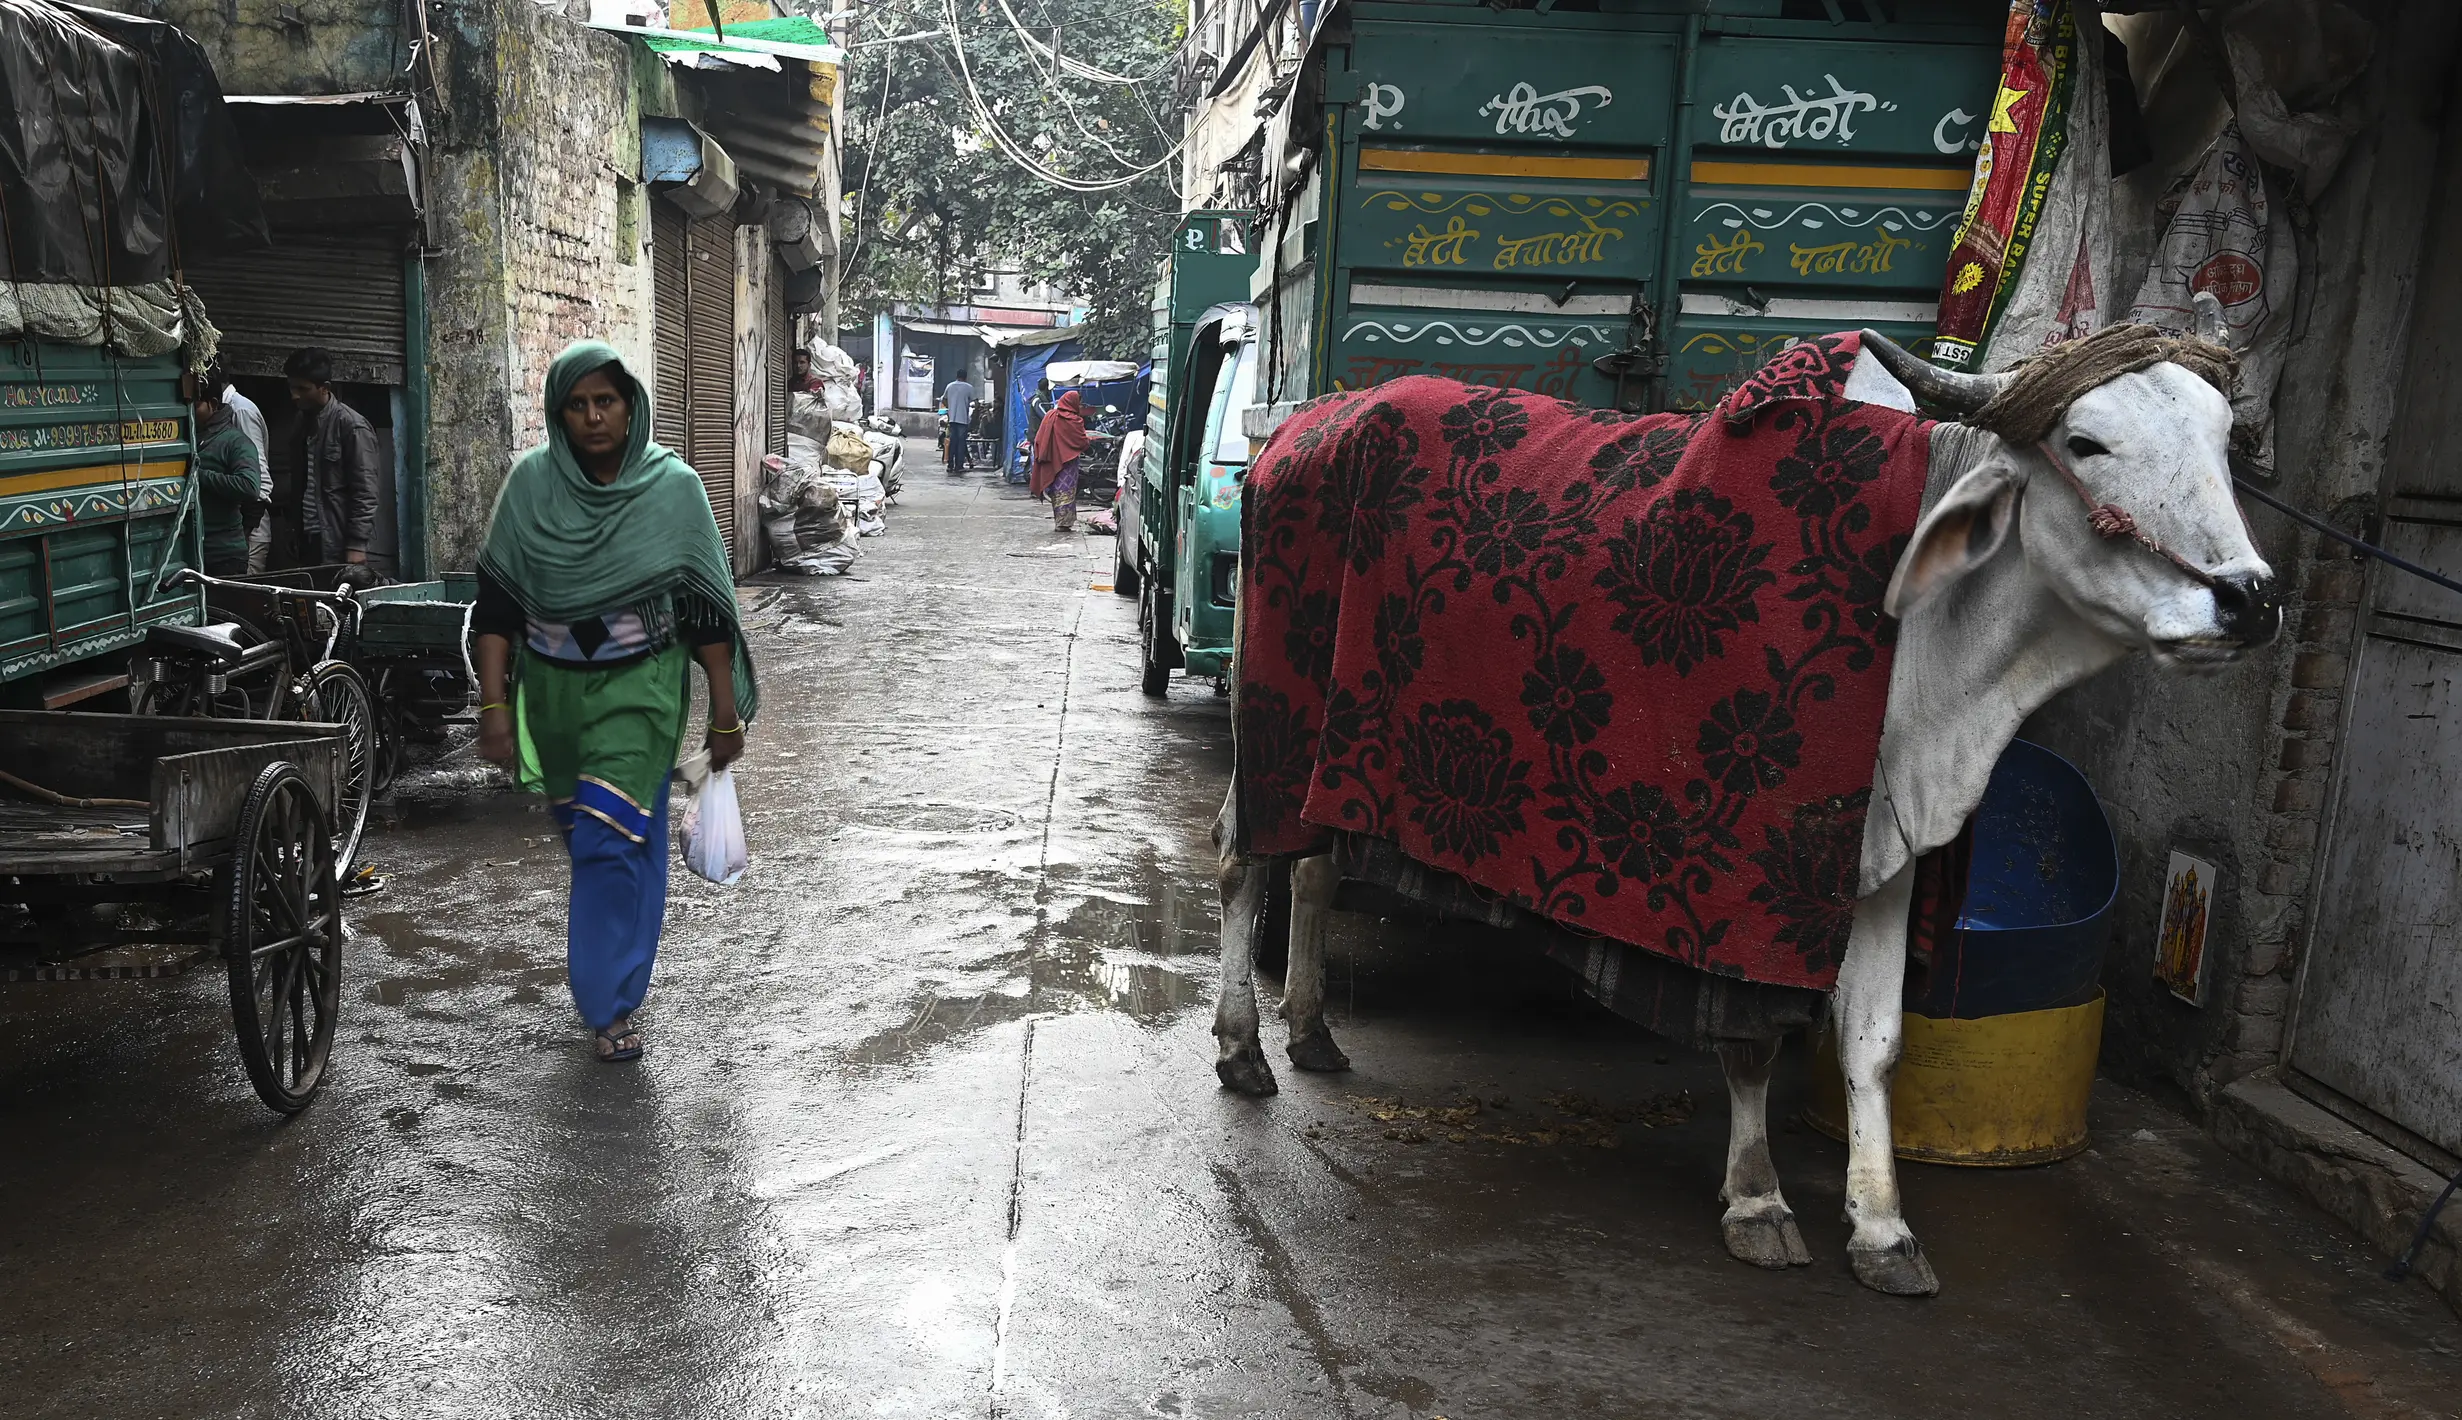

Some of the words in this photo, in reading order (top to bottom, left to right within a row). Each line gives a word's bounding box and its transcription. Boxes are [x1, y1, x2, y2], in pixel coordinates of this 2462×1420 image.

[1360, 82, 1405, 131] P.
[2017, 171, 2050, 240] SUPER
[1942, 346, 1971, 361] GST
